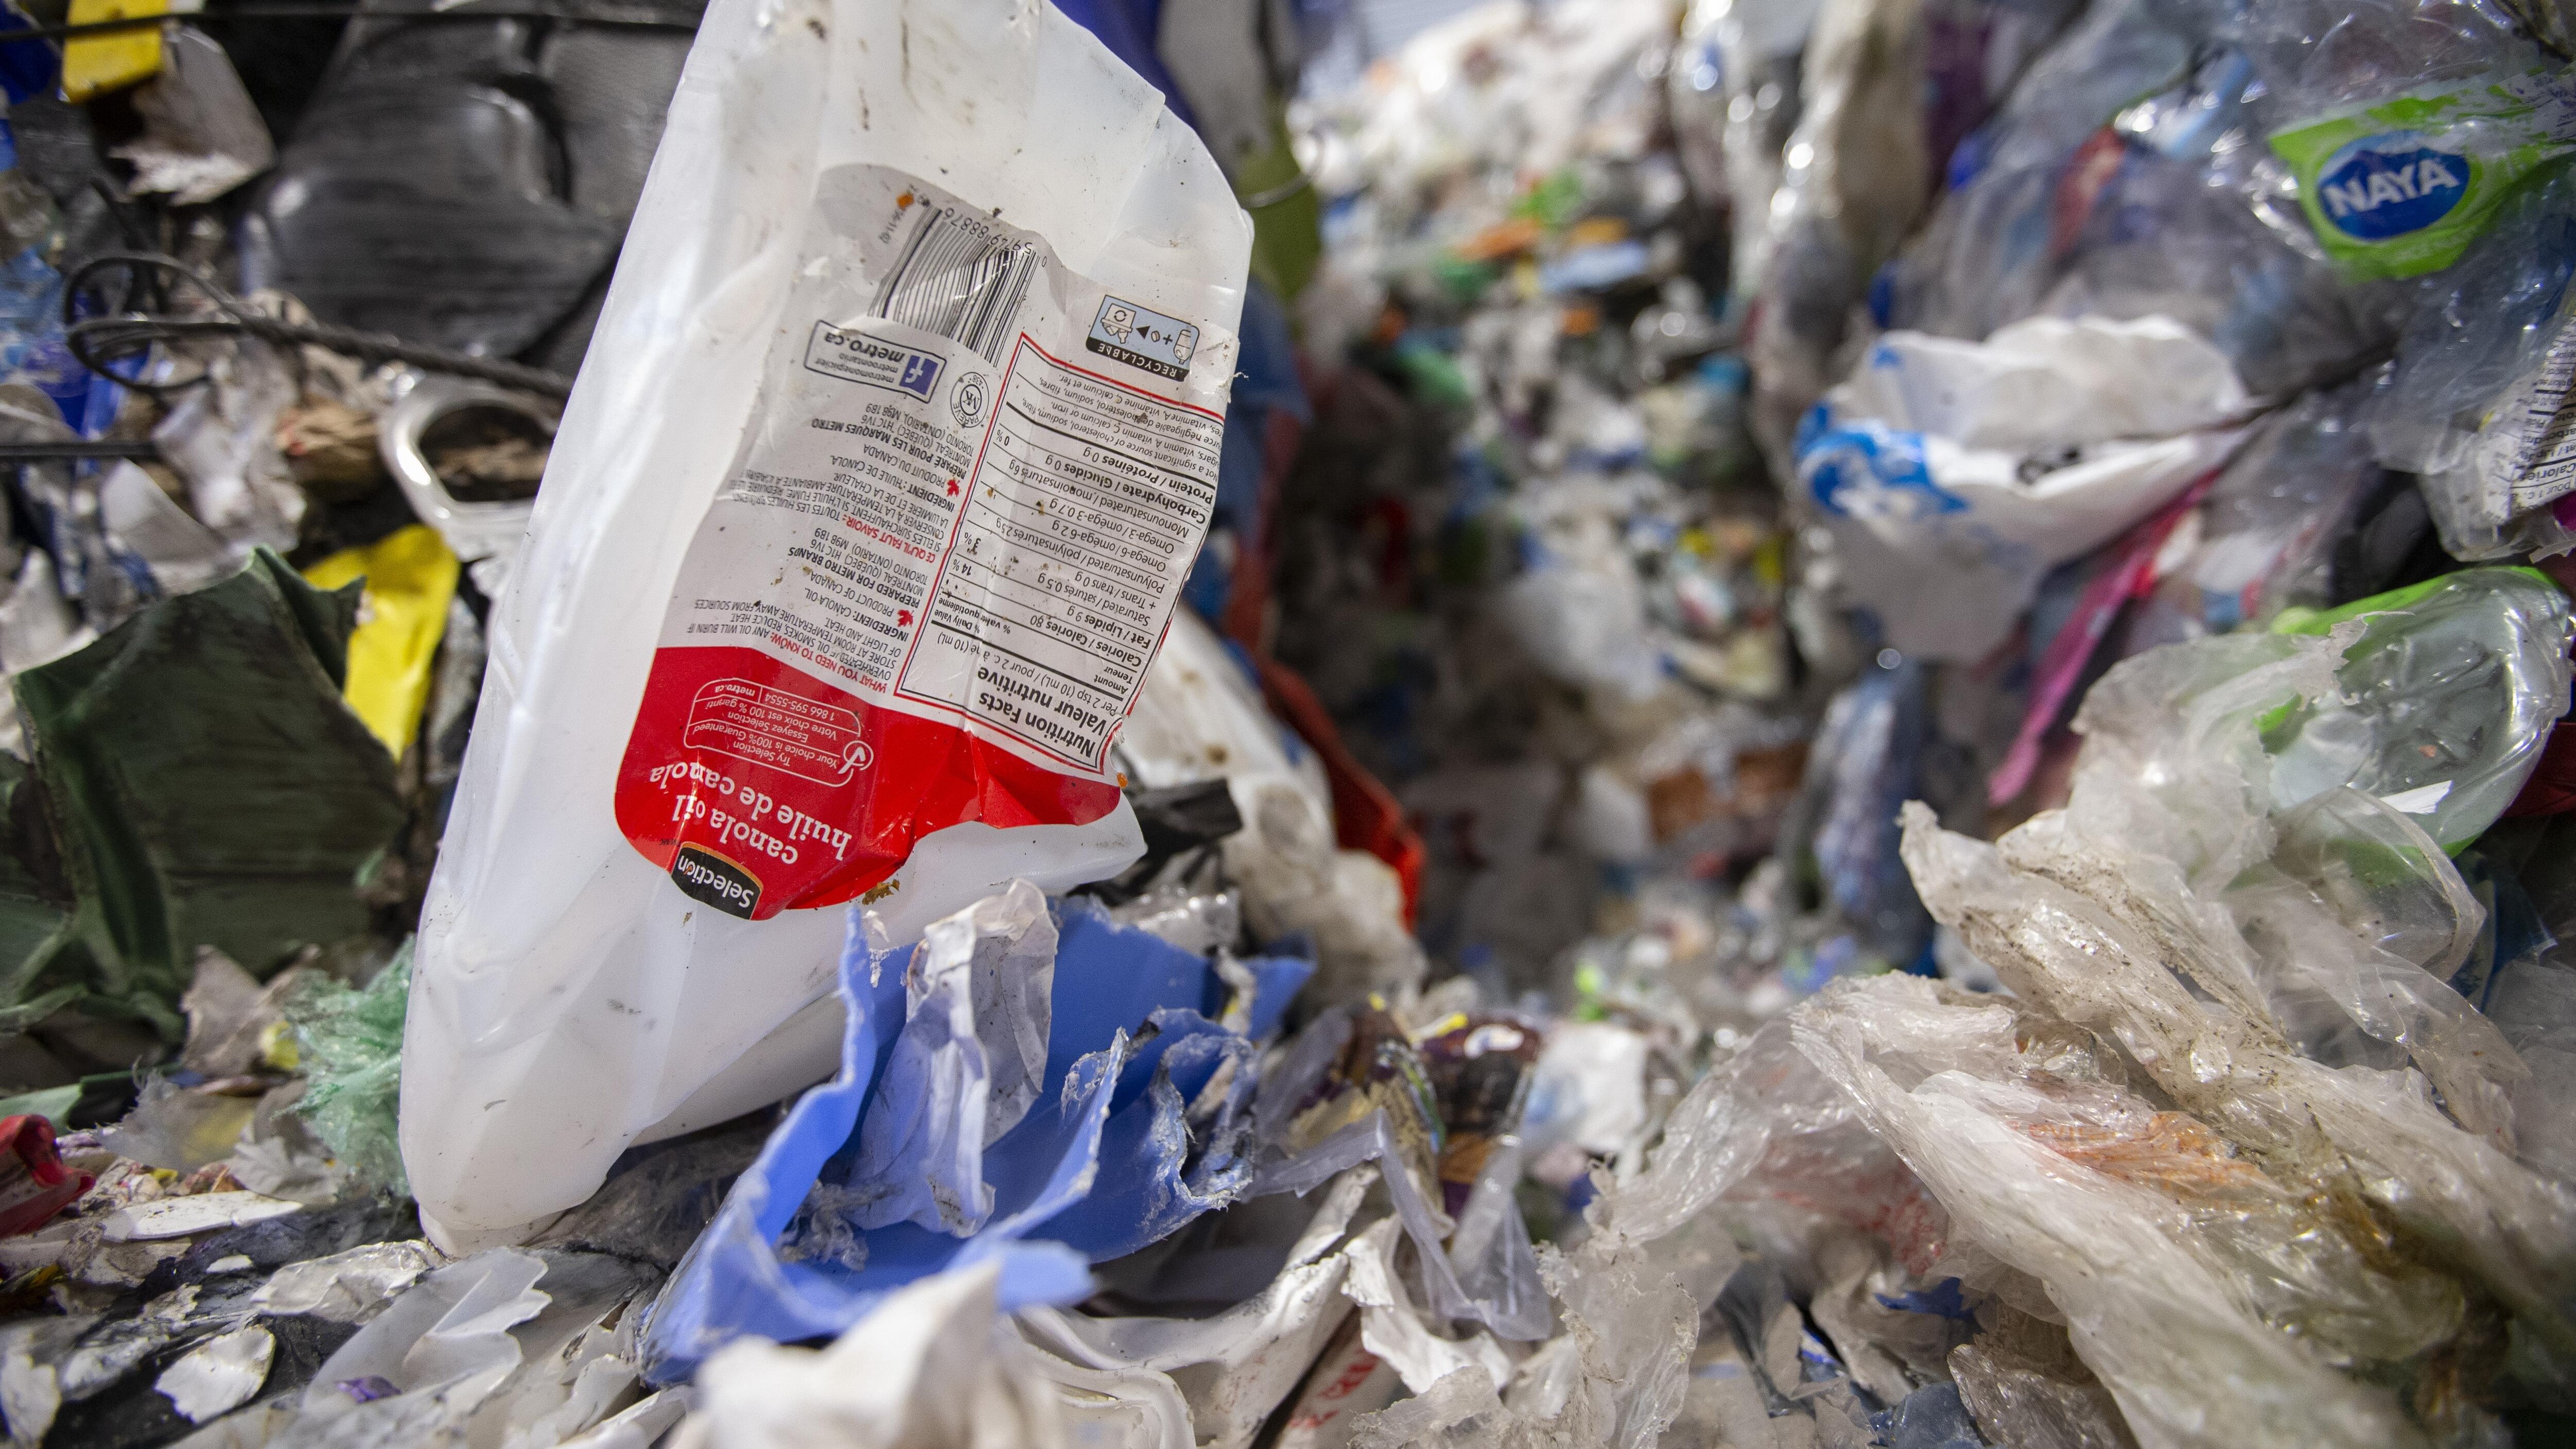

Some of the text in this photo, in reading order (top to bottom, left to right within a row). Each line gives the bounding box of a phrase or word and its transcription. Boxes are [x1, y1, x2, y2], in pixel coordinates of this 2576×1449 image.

[2324, 158, 2460, 218] NAYA
[824, 332, 905, 362] metro.ca
[1097, 343, 1177, 377] RECYCLABLE
[865, 402, 881, 414] 1B9
[1039, 377, 1094, 405] sodium, fibres,
[1050, 401, 1069, 413] iron.
[1059, 374, 1206, 429] vitamine vitamine calcium fer.
[952, 401, 979, 424] PAREVE
[1037, 408, 1068, 426] sodium,
[1070, 420, 1114, 443] cholesterol,
[1080, 413, 1110, 428] calcium
[844, 423, 891, 443] MARQUES
[860, 414, 971, 468] MONTRÉAL (QUÉBEC) 1V6
[891, 436, 908, 451] LES
[945, 433, 974, 457] TORONTO
[1122, 428, 1152, 444] vitamin
[1126, 442, 1153, 457] source
[1163, 442, 1194, 457] vitamin
[863, 444, 945, 488] PRODUIT CANADA
[908, 444, 934, 463] POUR
[934, 455, 967, 479] PRÉPARÉ
[1154, 451, 1196, 469] significant
[833, 472, 940, 524] LUMIÈRE CHALEUR.
[877, 469, 955, 512] INGRÉDIENT HUILE
[1063, 463, 1205, 524] Carbohydrate Glucides
[1101, 455, 1213, 504] Protein Protéines
[825, 482, 944, 540] CONSERVER TEMPÉRATURE
[850, 504, 912, 540] SURCHAUFFENT.
[1020, 467, 1189, 538] Monounsaturated monoinsaturés
[795, 501, 926, 559] QU'IL FAUT SAVOIR TOUTES LES
[911, 532, 934, 549] ELLES
[1057, 504, 1174, 553] Omega-3 oméga-3 0.7
[809, 538, 924, 596] MONTRÉAL (QUÉBEC) H1C 1V6
[814, 527, 927, 585] TORONTO (ONTARIO) M9B 1B9
[1001, 523, 1165, 594] Polyunsaturated polyinsaturés 2.5
[1069, 528, 1166, 571] Omega-6 oméga-6
[787, 547, 920, 608] PREPARED FOR METRO BRANDS
[961, 563, 972, 576] 14
[810, 569, 894, 617] PRODUCT CANADA
[938, 597, 979, 618] quotidienne
[1045, 578, 1150, 626] Saturated saturés 0.5
[1091, 579, 1145, 609] Trans trans
[751, 614, 829, 653] OIL SMOKES, REDUCE
[804, 587, 909, 642] INGREDIENT: CANOLA OIL.
[934, 609, 973, 630] Daily Value
[1084, 614, 1151, 649] Fat Lipides
[731, 601, 896, 669] STORE ROOM TEMPERATURE AWAY FROM
[824, 617, 888, 652] LIGHT AND HEAT.
[1029, 615, 1141, 667] Calories Calories 80
[720, 624, 887, 693] WHAT YOU NEED KNOW: ANY OIL WILL
[937, 631, 1118, 716] Per tsp (10 mL) pour (10 mL)
[1103, 666, 1132, 684] Teneur
[715, 684, 828, 719] 866 595-5554 metro.ca
[977, 666, 1107, 736] Valeur nutritive
[1093, 674, 1128, 694] Amount
[705, 697, 836, 740] Votre choix est 100 garanti
[727, 711, 808, 743] Essayez Selection
[978, 692, 1096, 757] Nutrition Facts
[692, 722, 837, 768] Your choice is 100% Guaranteed
[733, 740, 790, 766] Try Selection
[649, 761, 852, 861] huile de canola
[672, 794, 798, 864] canola oil
[677, 855, 754, 907] Selection
